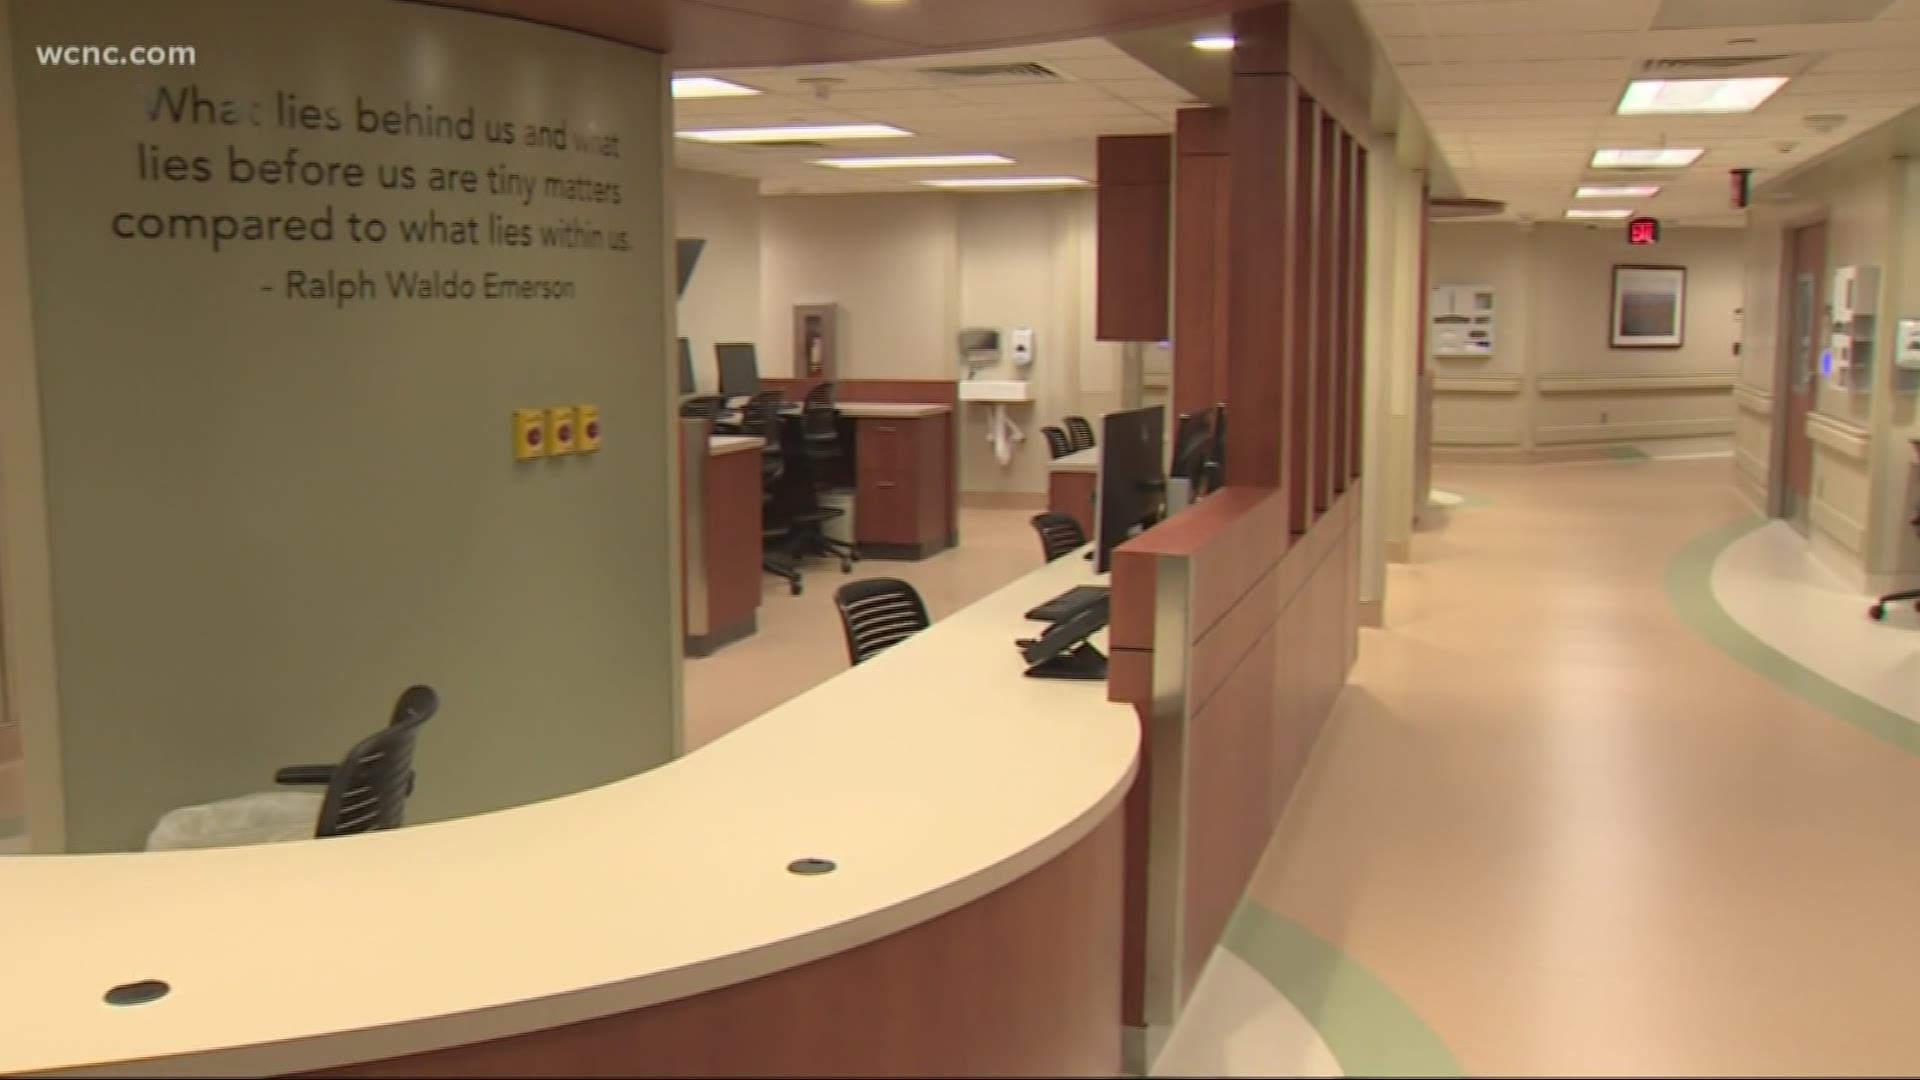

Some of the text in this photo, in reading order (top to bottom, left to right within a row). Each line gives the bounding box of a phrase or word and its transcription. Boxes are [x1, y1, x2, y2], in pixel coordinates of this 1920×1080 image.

[145, 84, 262, 127] What
[276, 90, 341, 131] lies
[356, 96, 475, 142] behind
[485, 119, 515, 145] us
[525, 121, 567, 151] and
[138, 143, 622, 207] lies before us are tiny matters
[112, 205, 334, 252] compared
[349, 213, 387, 243] to
[400, 209, 479, 246] what
[489, 212, 532, 247] lies
[540, 217, 604, 249] within
[286, 269, 376, 308] Ralph
[385, 270, 476, 300] Waldo
[483, 271, 575, 300] Emerson
